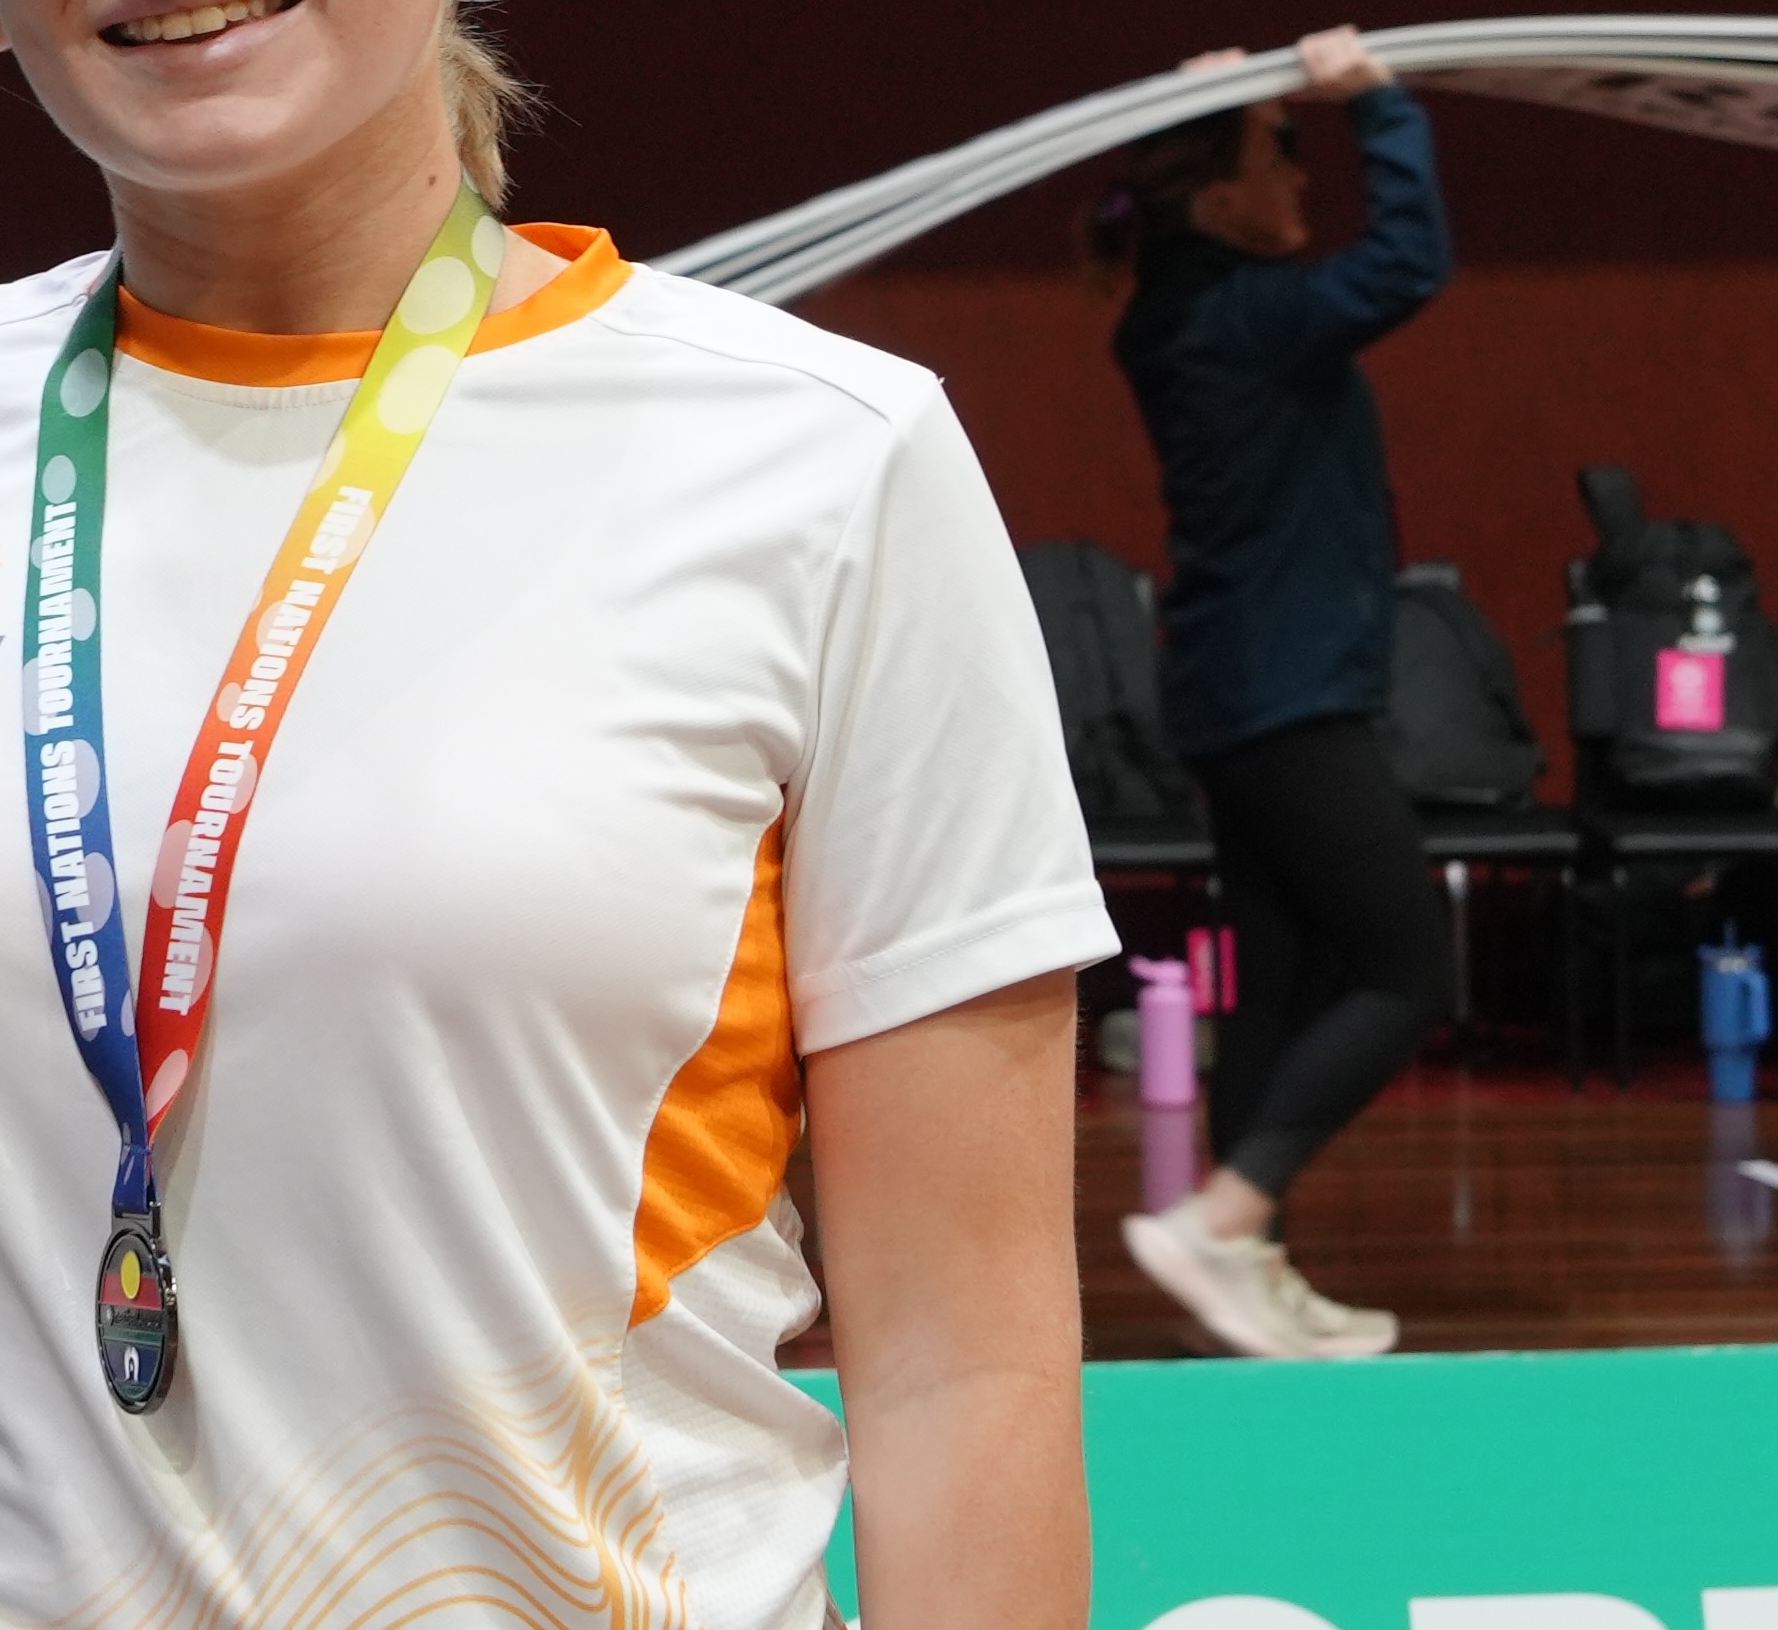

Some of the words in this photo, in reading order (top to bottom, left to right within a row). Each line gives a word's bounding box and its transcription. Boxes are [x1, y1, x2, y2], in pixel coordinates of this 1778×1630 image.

[300, 484, 374, 577] FIRST
[35, 501, 78, 732] TOURNAMENT
[228, 577, 327, 731] NATIONS
[39, 739, 91, 909] NATIONS
[159, 739, 256, 1017] TOURNAMENT
[60, 921, 108, 1030] FIRST
